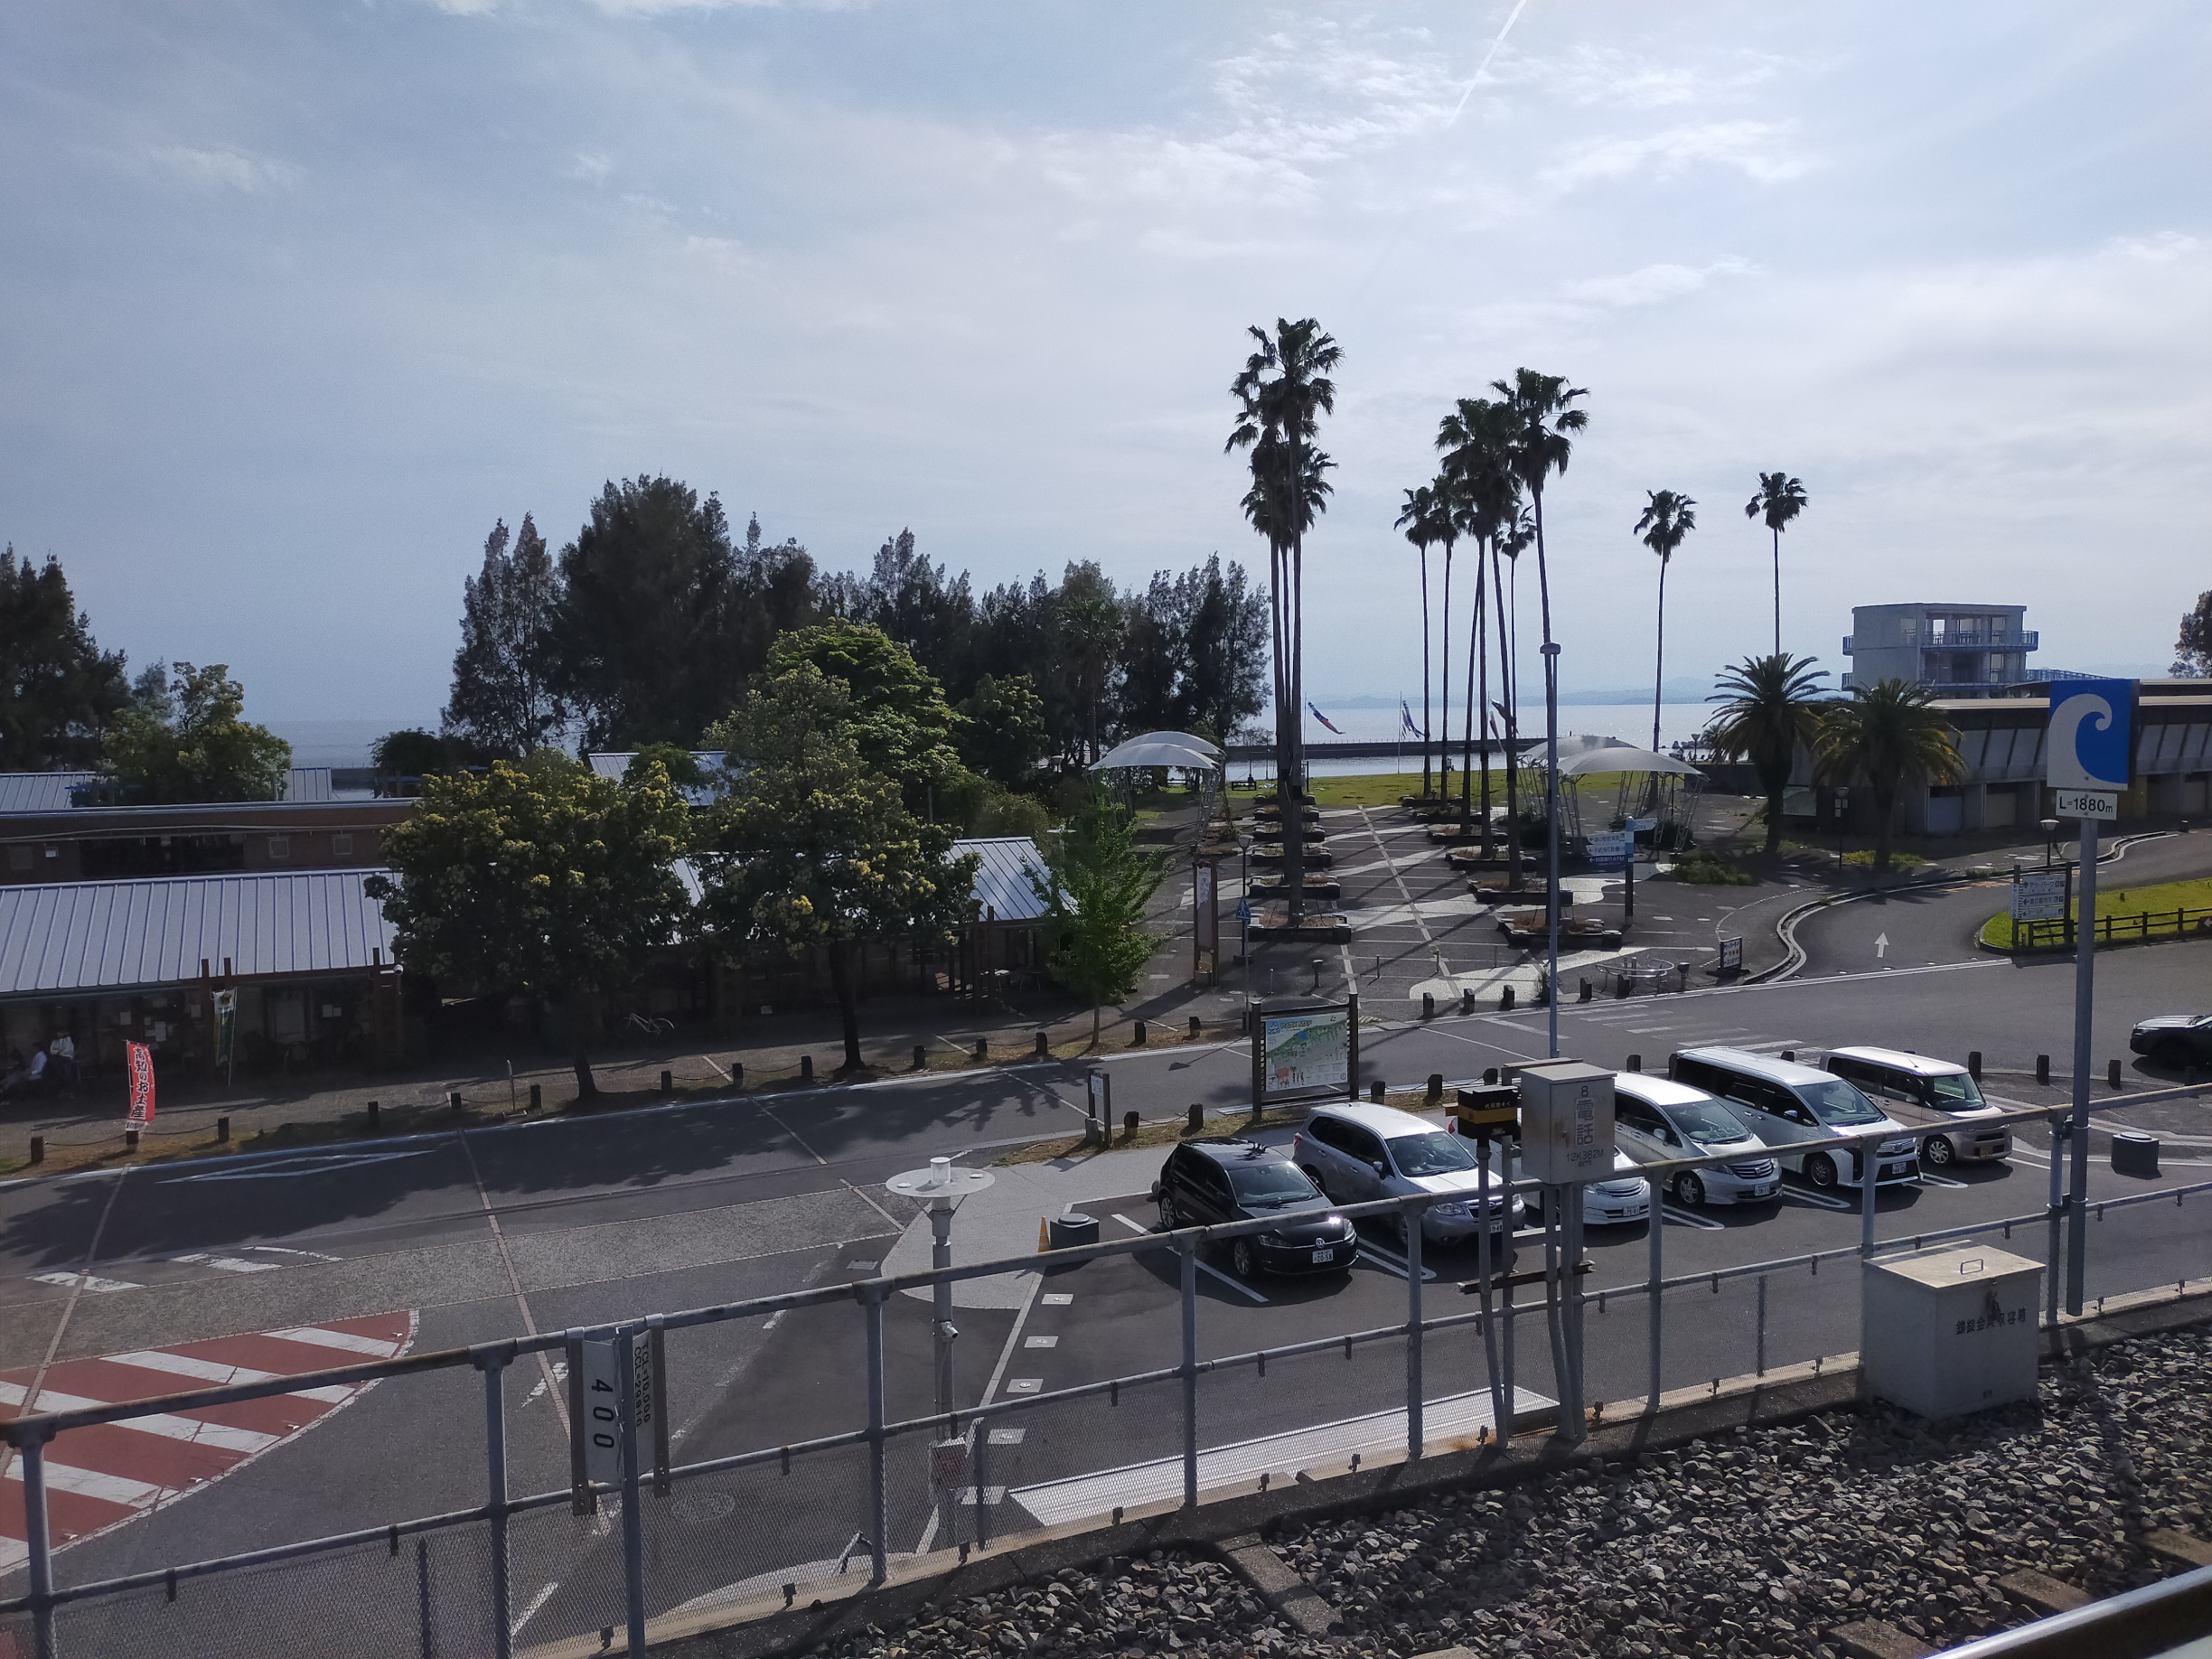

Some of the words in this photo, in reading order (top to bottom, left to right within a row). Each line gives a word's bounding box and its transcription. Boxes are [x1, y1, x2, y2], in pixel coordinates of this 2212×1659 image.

[2059, 796, 2113, 813] L=1880m
[131, 1046, 149, 1120] 高知のお土産
[1580, 1085, 1589, 1098] 8
[1576, 1099, 1594, 1146] 電話
[1566, 1148, 1604, 1163] 12K382M
[591, 1378, 614, 1448] 400
